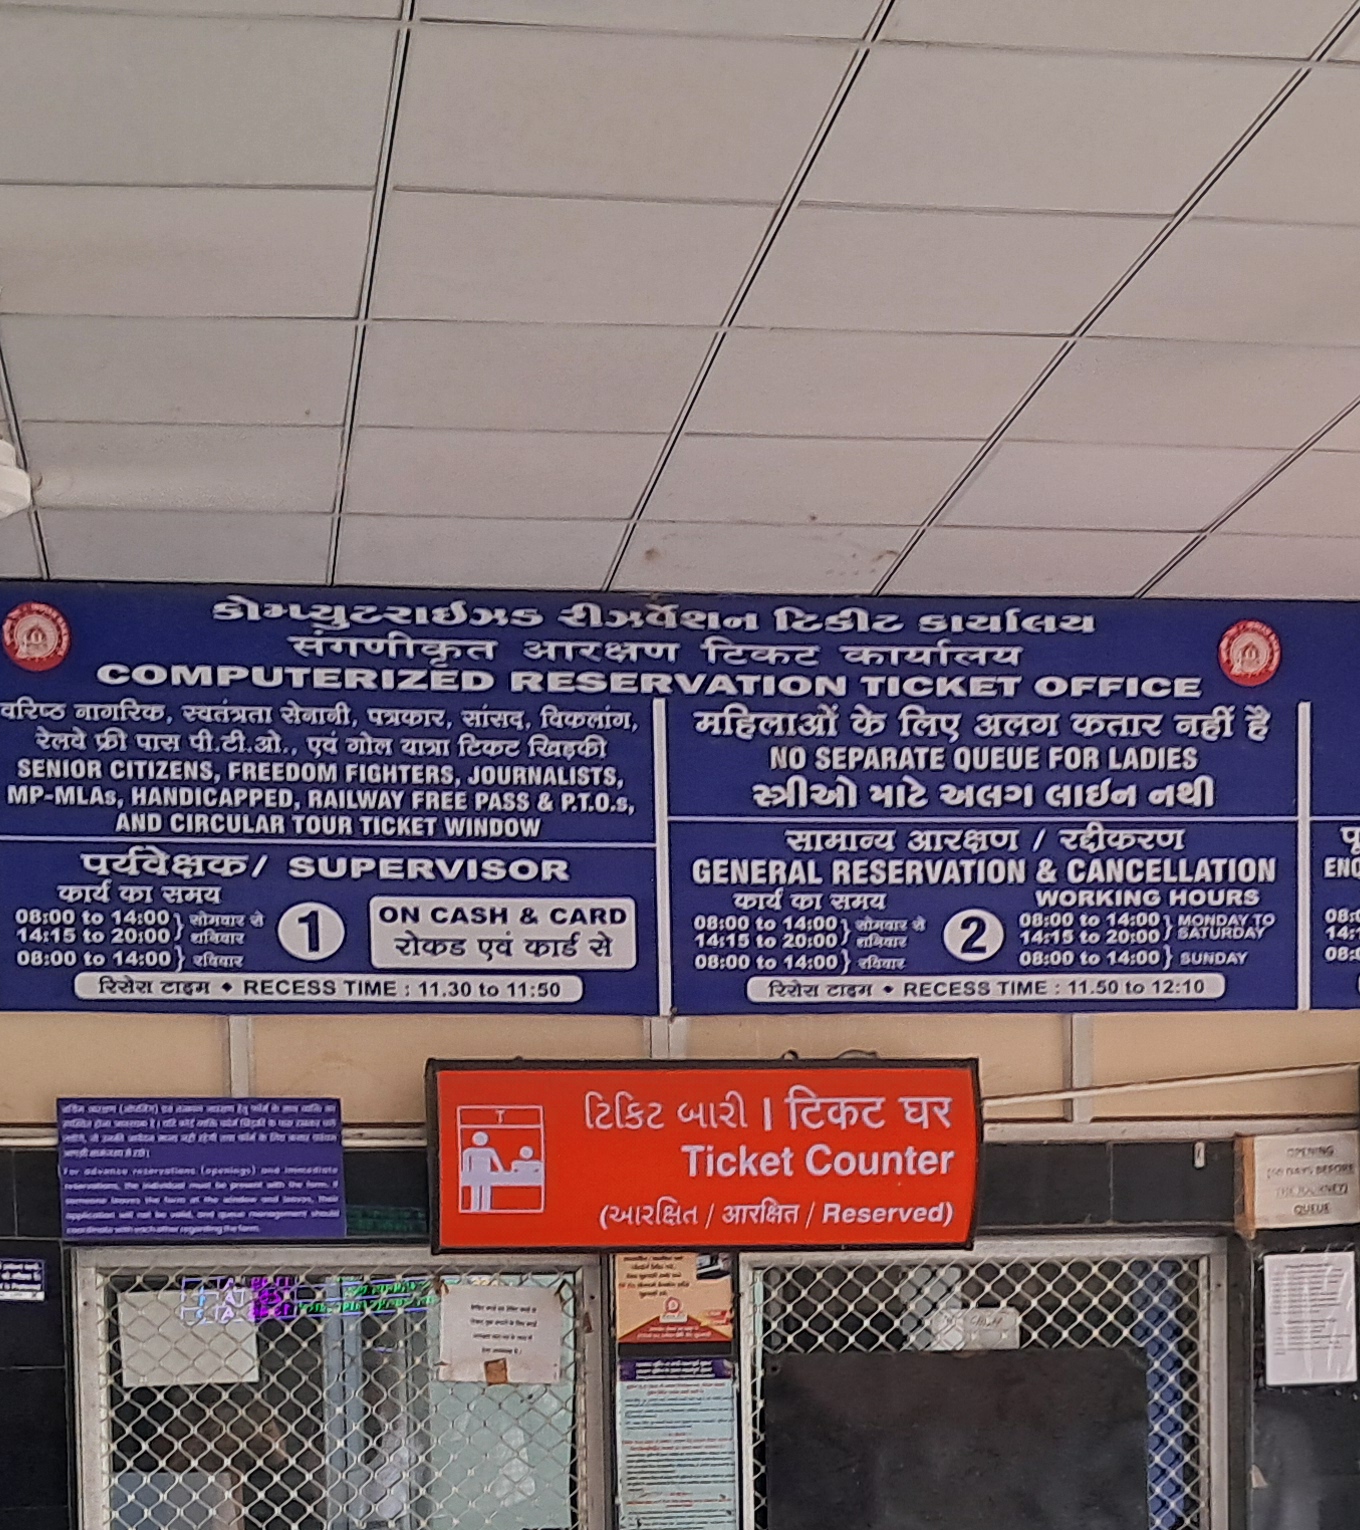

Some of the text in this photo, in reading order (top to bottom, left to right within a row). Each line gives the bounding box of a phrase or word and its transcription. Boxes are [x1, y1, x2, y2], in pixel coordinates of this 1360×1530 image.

[286, 629, 1024, 669] संगणीकृत आरक्षण टिकट कार्यालय
[96, 663, 1202, 698] COMPUTERIZED RESERVATION TICKET OFFICE
[692, 702, 1271, 744] महिलाओं के लिए अलग कतार नहीं है
[17, 758, 624, 790] SENIOR CITIZENS, FREEDOM FIGHTERS, JOURNALISTS,
[770, 745, 1198, 773] NO SEPARATE QUEUE FOR LADIES
[7, 784, 635, 816] MP-MLAs, HANDICAPPED, RAILWAY FREE PASS & P.T.O.s,
[115, 812, 541, 838] AND CIRCULAR TOUR TICKET WINDOW
[288, 856, 570, 881] SUPERVISOR
[692, 857, 1276, 885] GENERAL RESERVATION & CANCELLATION
[1034, 888, 1260, 908] WORKING HOURS
[15, 908, 170, 926] 08:00 to 14:00
[378, 905, 627, 925] ON CASH & CARD
[16, 926, 171, 944] 14:15 to 20:00
[297, 910, 320, 953] 1
[960, 915, 987, 954] 2
[243, 979, 561, 998] RECESS TIME 11.30 to 11:50
[584, 1084, 953, 1131] ટિકિટ બારી टिकट घर
[680, 1143, 955, 1177] Ticket Counter
